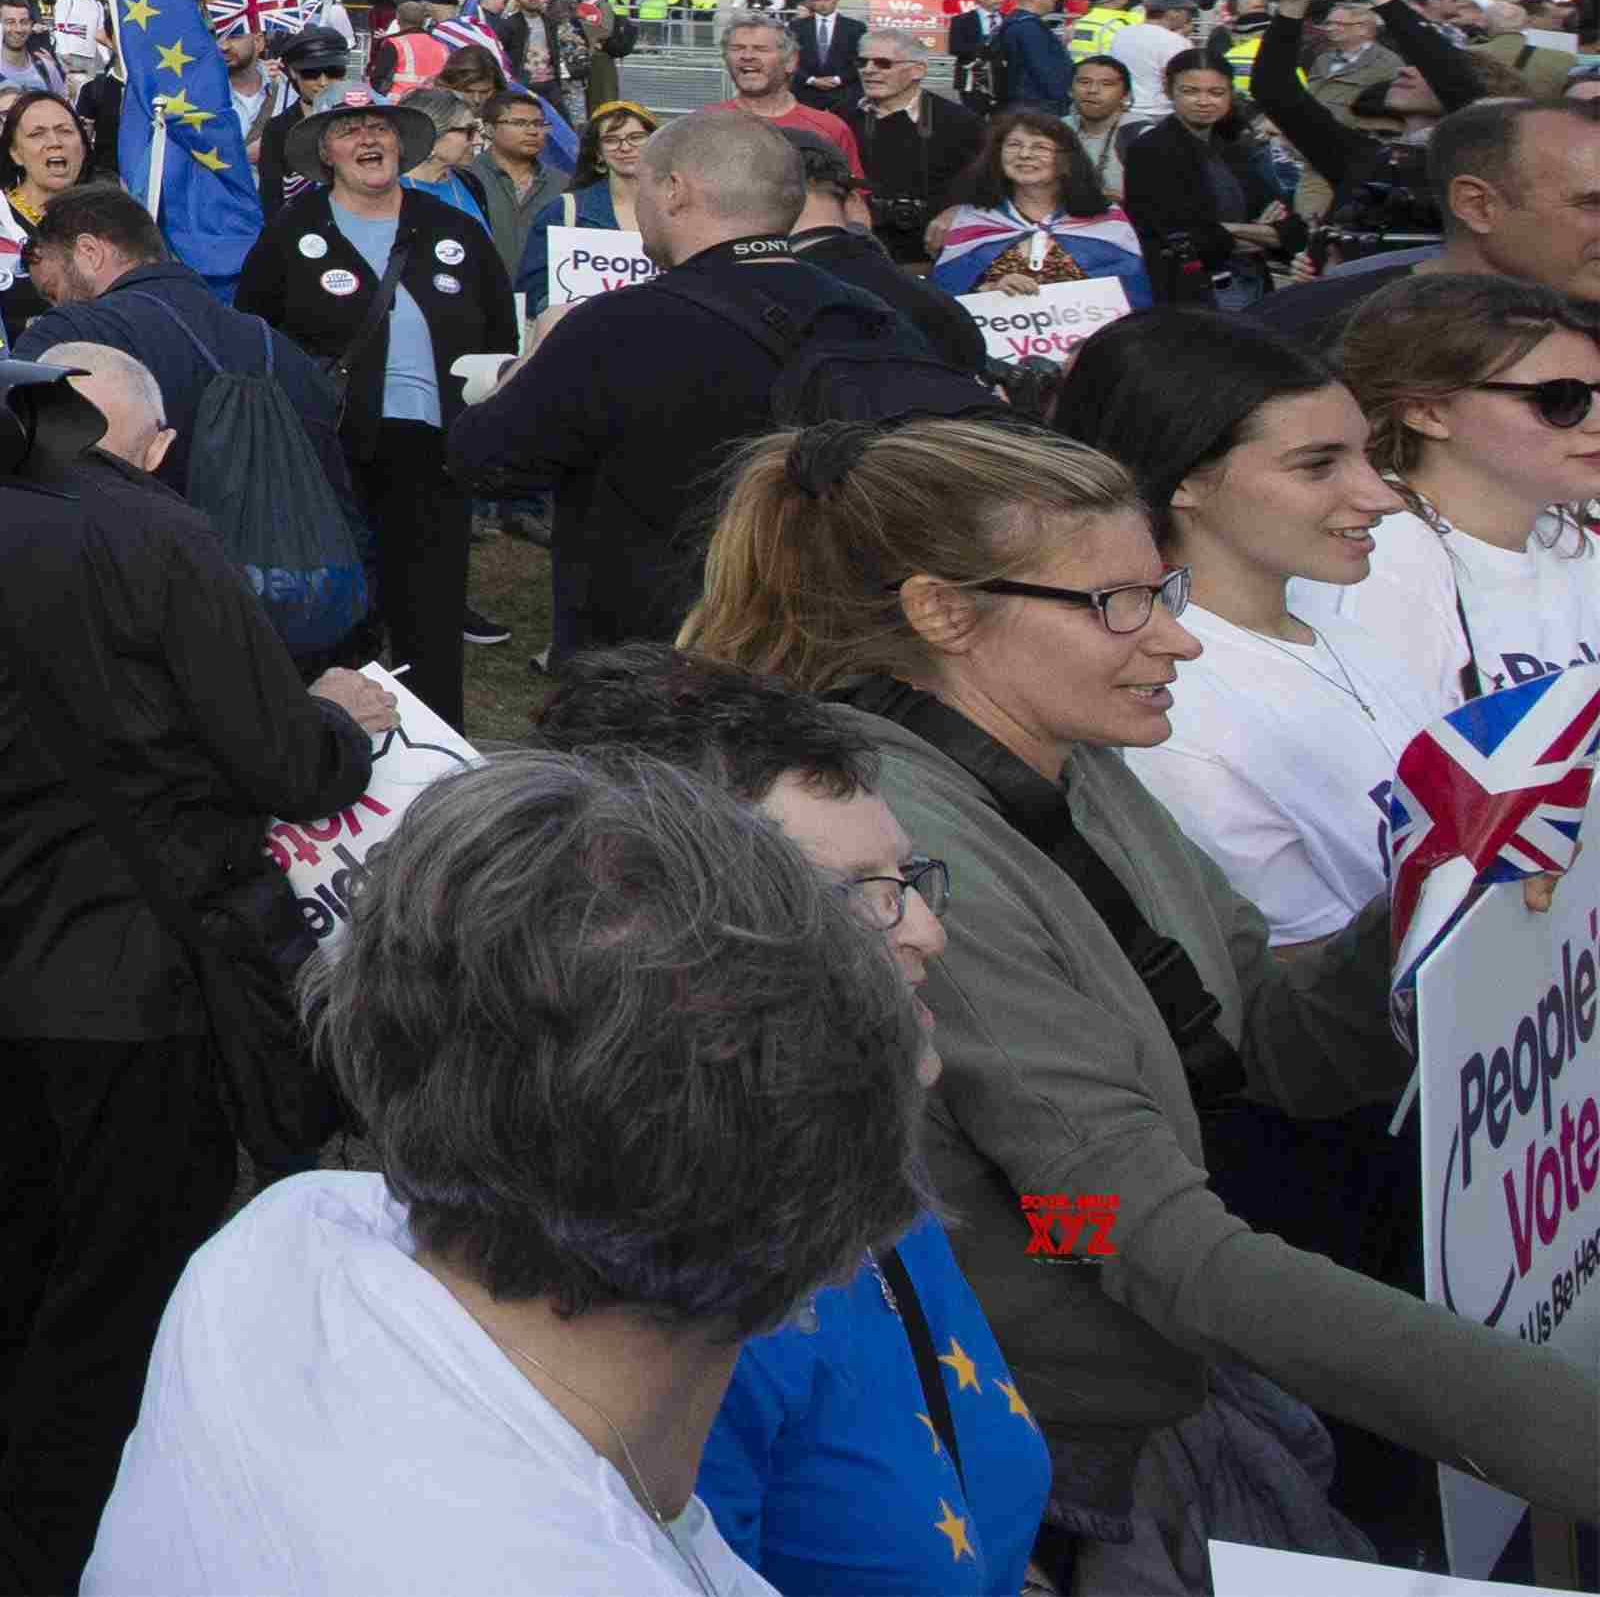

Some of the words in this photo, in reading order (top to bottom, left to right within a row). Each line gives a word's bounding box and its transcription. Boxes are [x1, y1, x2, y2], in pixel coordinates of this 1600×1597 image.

[732, 240, 790, 255] SONY
[1460, 906, 1600, 1190] People'
[1503, 1097, 1600, 1279] Vote
[1552, 1270, 1574, 1327] Be
